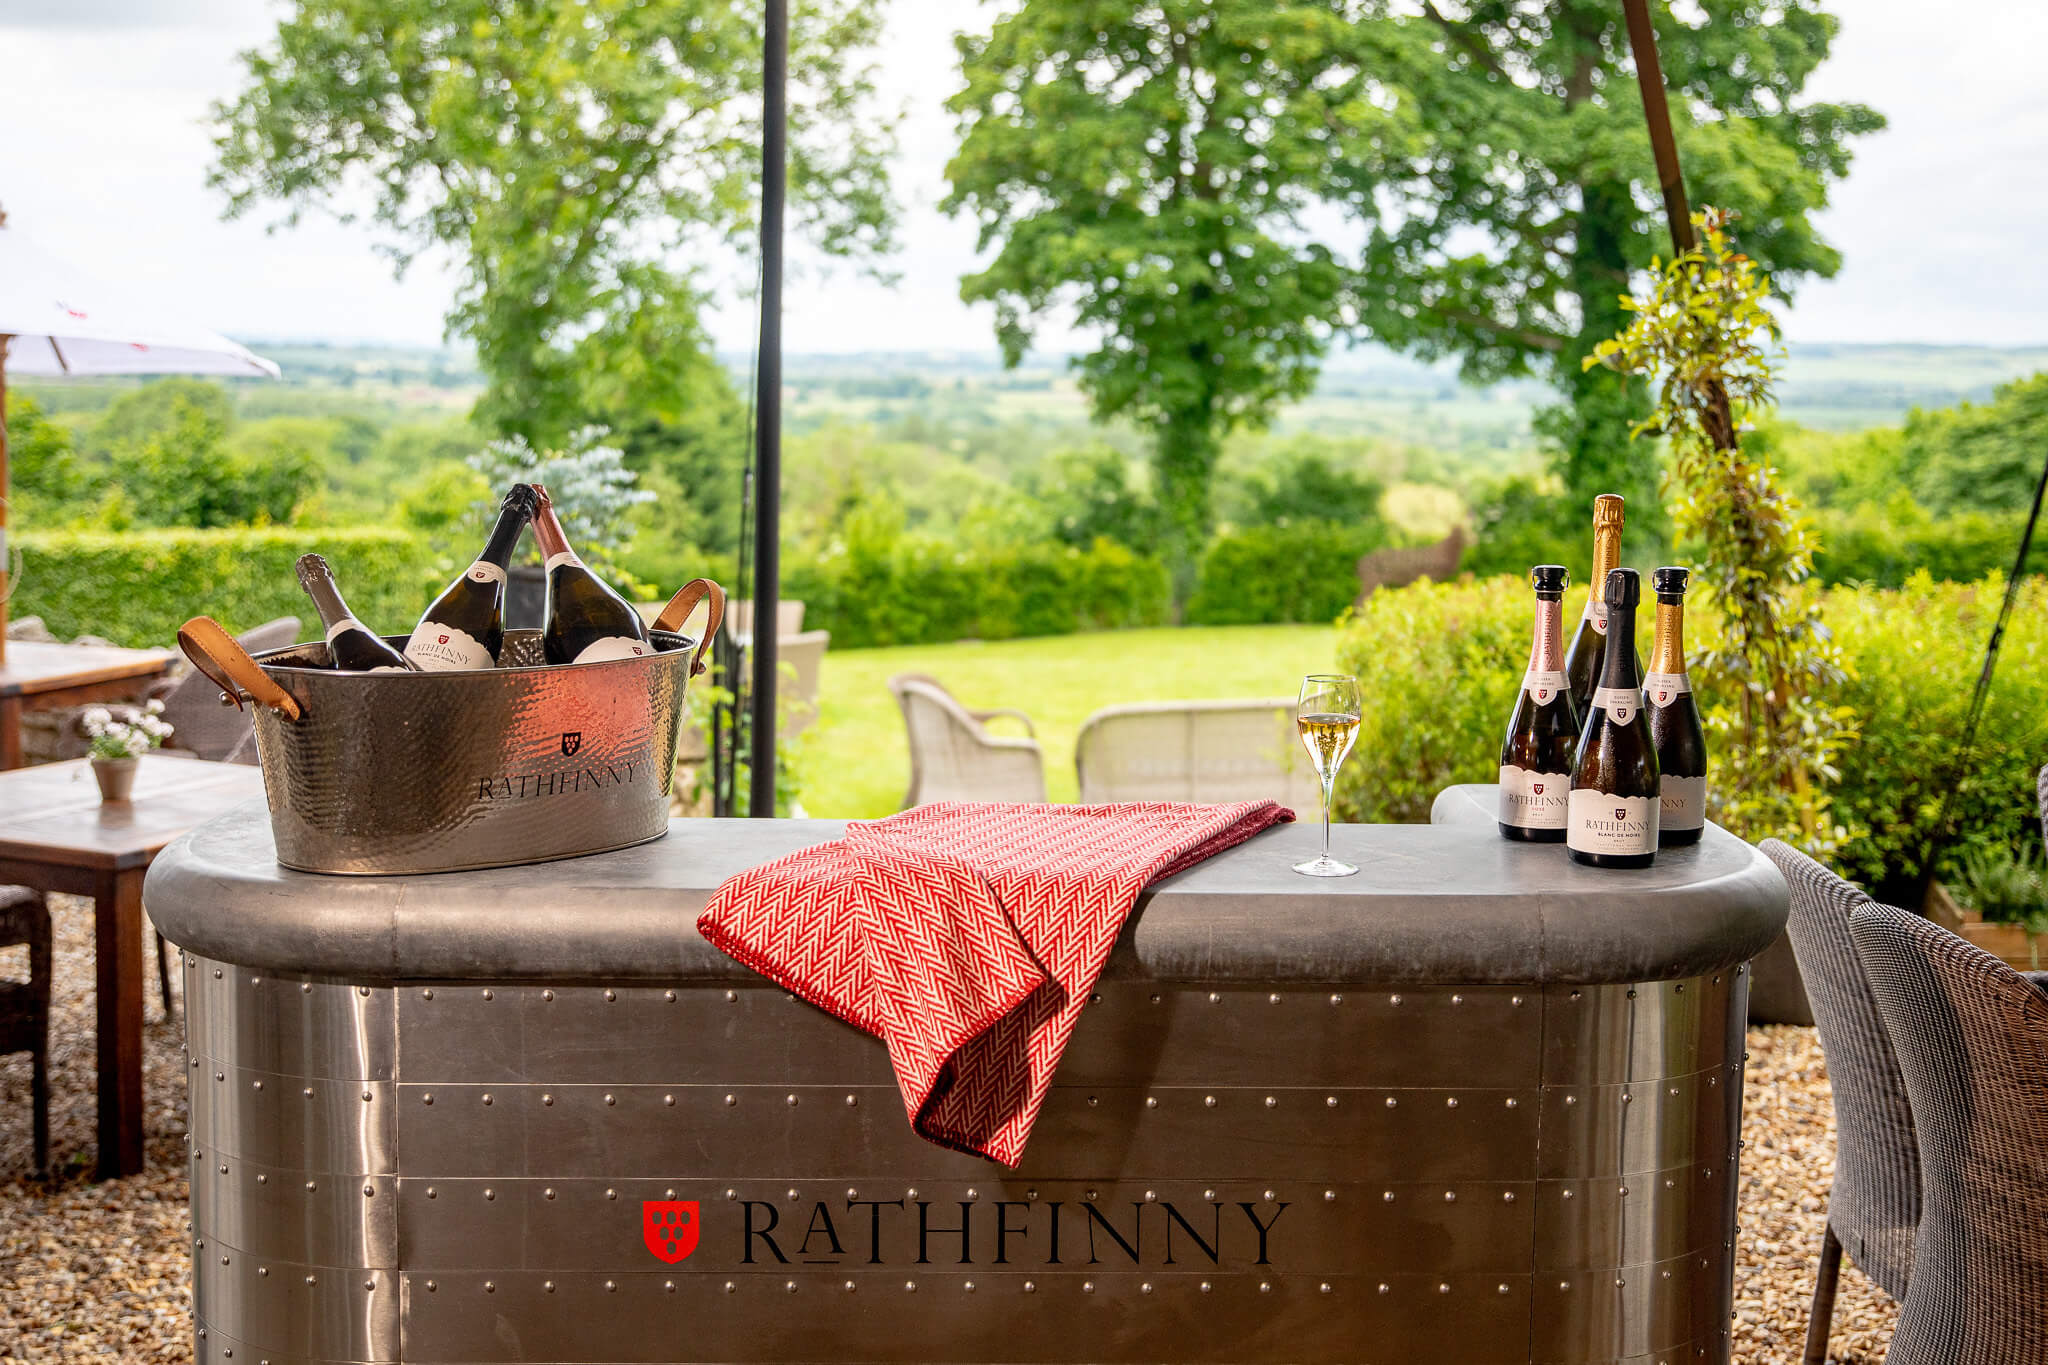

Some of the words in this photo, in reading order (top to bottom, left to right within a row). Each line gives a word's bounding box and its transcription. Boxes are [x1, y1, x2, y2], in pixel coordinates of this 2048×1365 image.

[478, 760, 640, 800] RATHFINNY
[1508, 793, 1569, 807] RATHFINNY
[1586, 819, 1649, 832] RATHFINNY
[739, 1200, 1292, 1266] RATHFINNY
